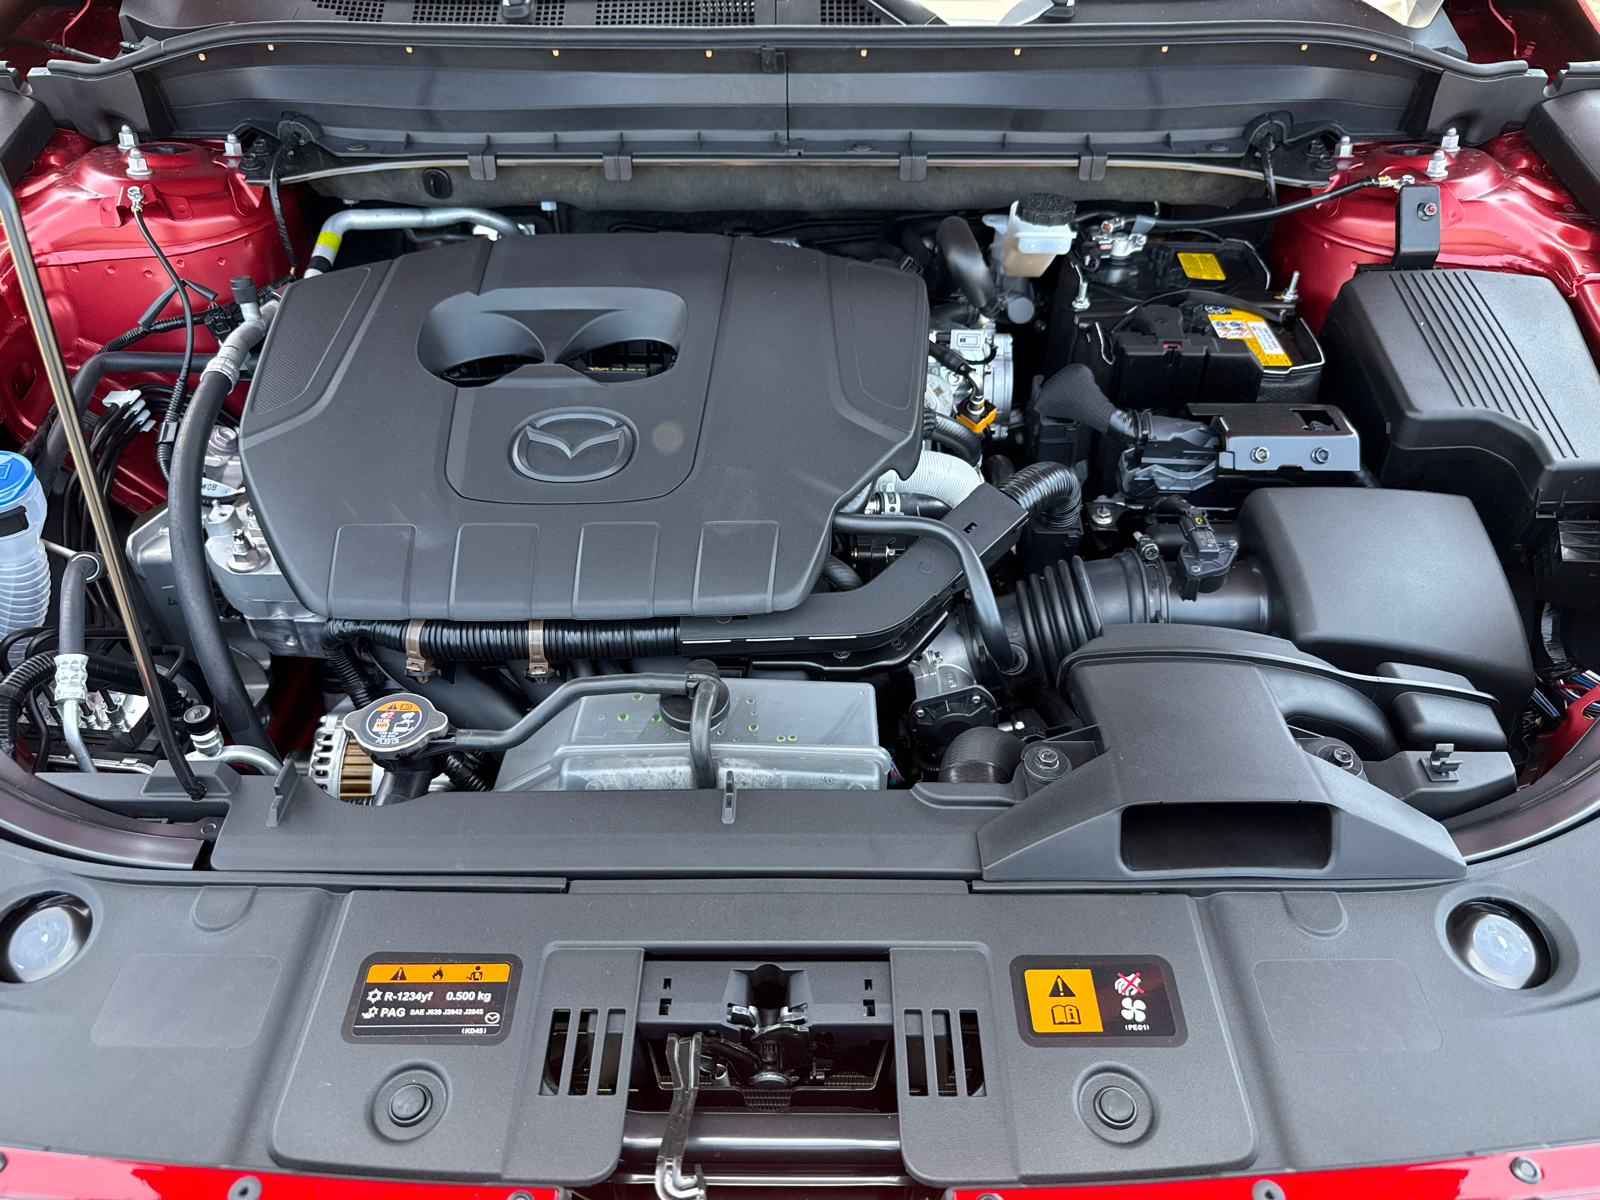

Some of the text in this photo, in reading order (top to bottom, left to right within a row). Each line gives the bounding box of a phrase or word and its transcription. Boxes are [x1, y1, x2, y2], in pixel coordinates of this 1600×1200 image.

[384, 991, 492, 1003] R-1234yf 0.500 kg
[380, 1007, 406, 1017] PAG
